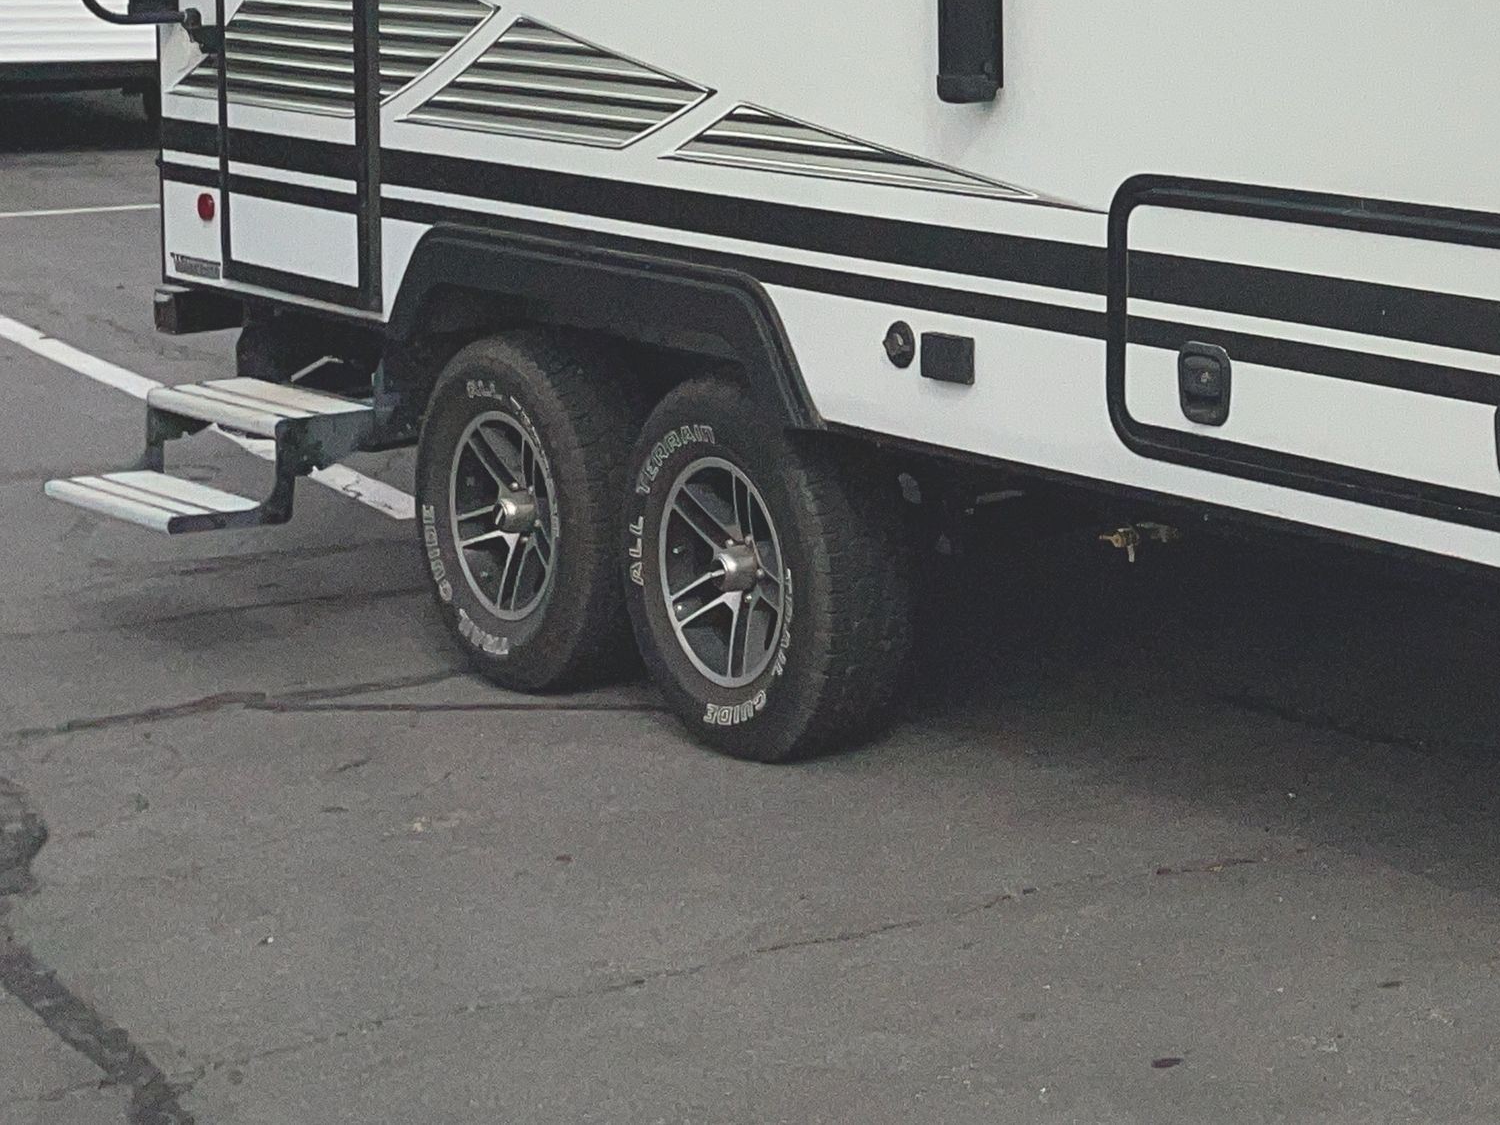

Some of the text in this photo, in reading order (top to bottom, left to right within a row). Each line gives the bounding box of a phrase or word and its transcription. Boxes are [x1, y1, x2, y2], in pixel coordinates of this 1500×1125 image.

[422, 504, 453, 601] GUIDE
[629, 425, 716, 586] ALL TERRAIN
[703, 690, 766, 726] GUIDE
